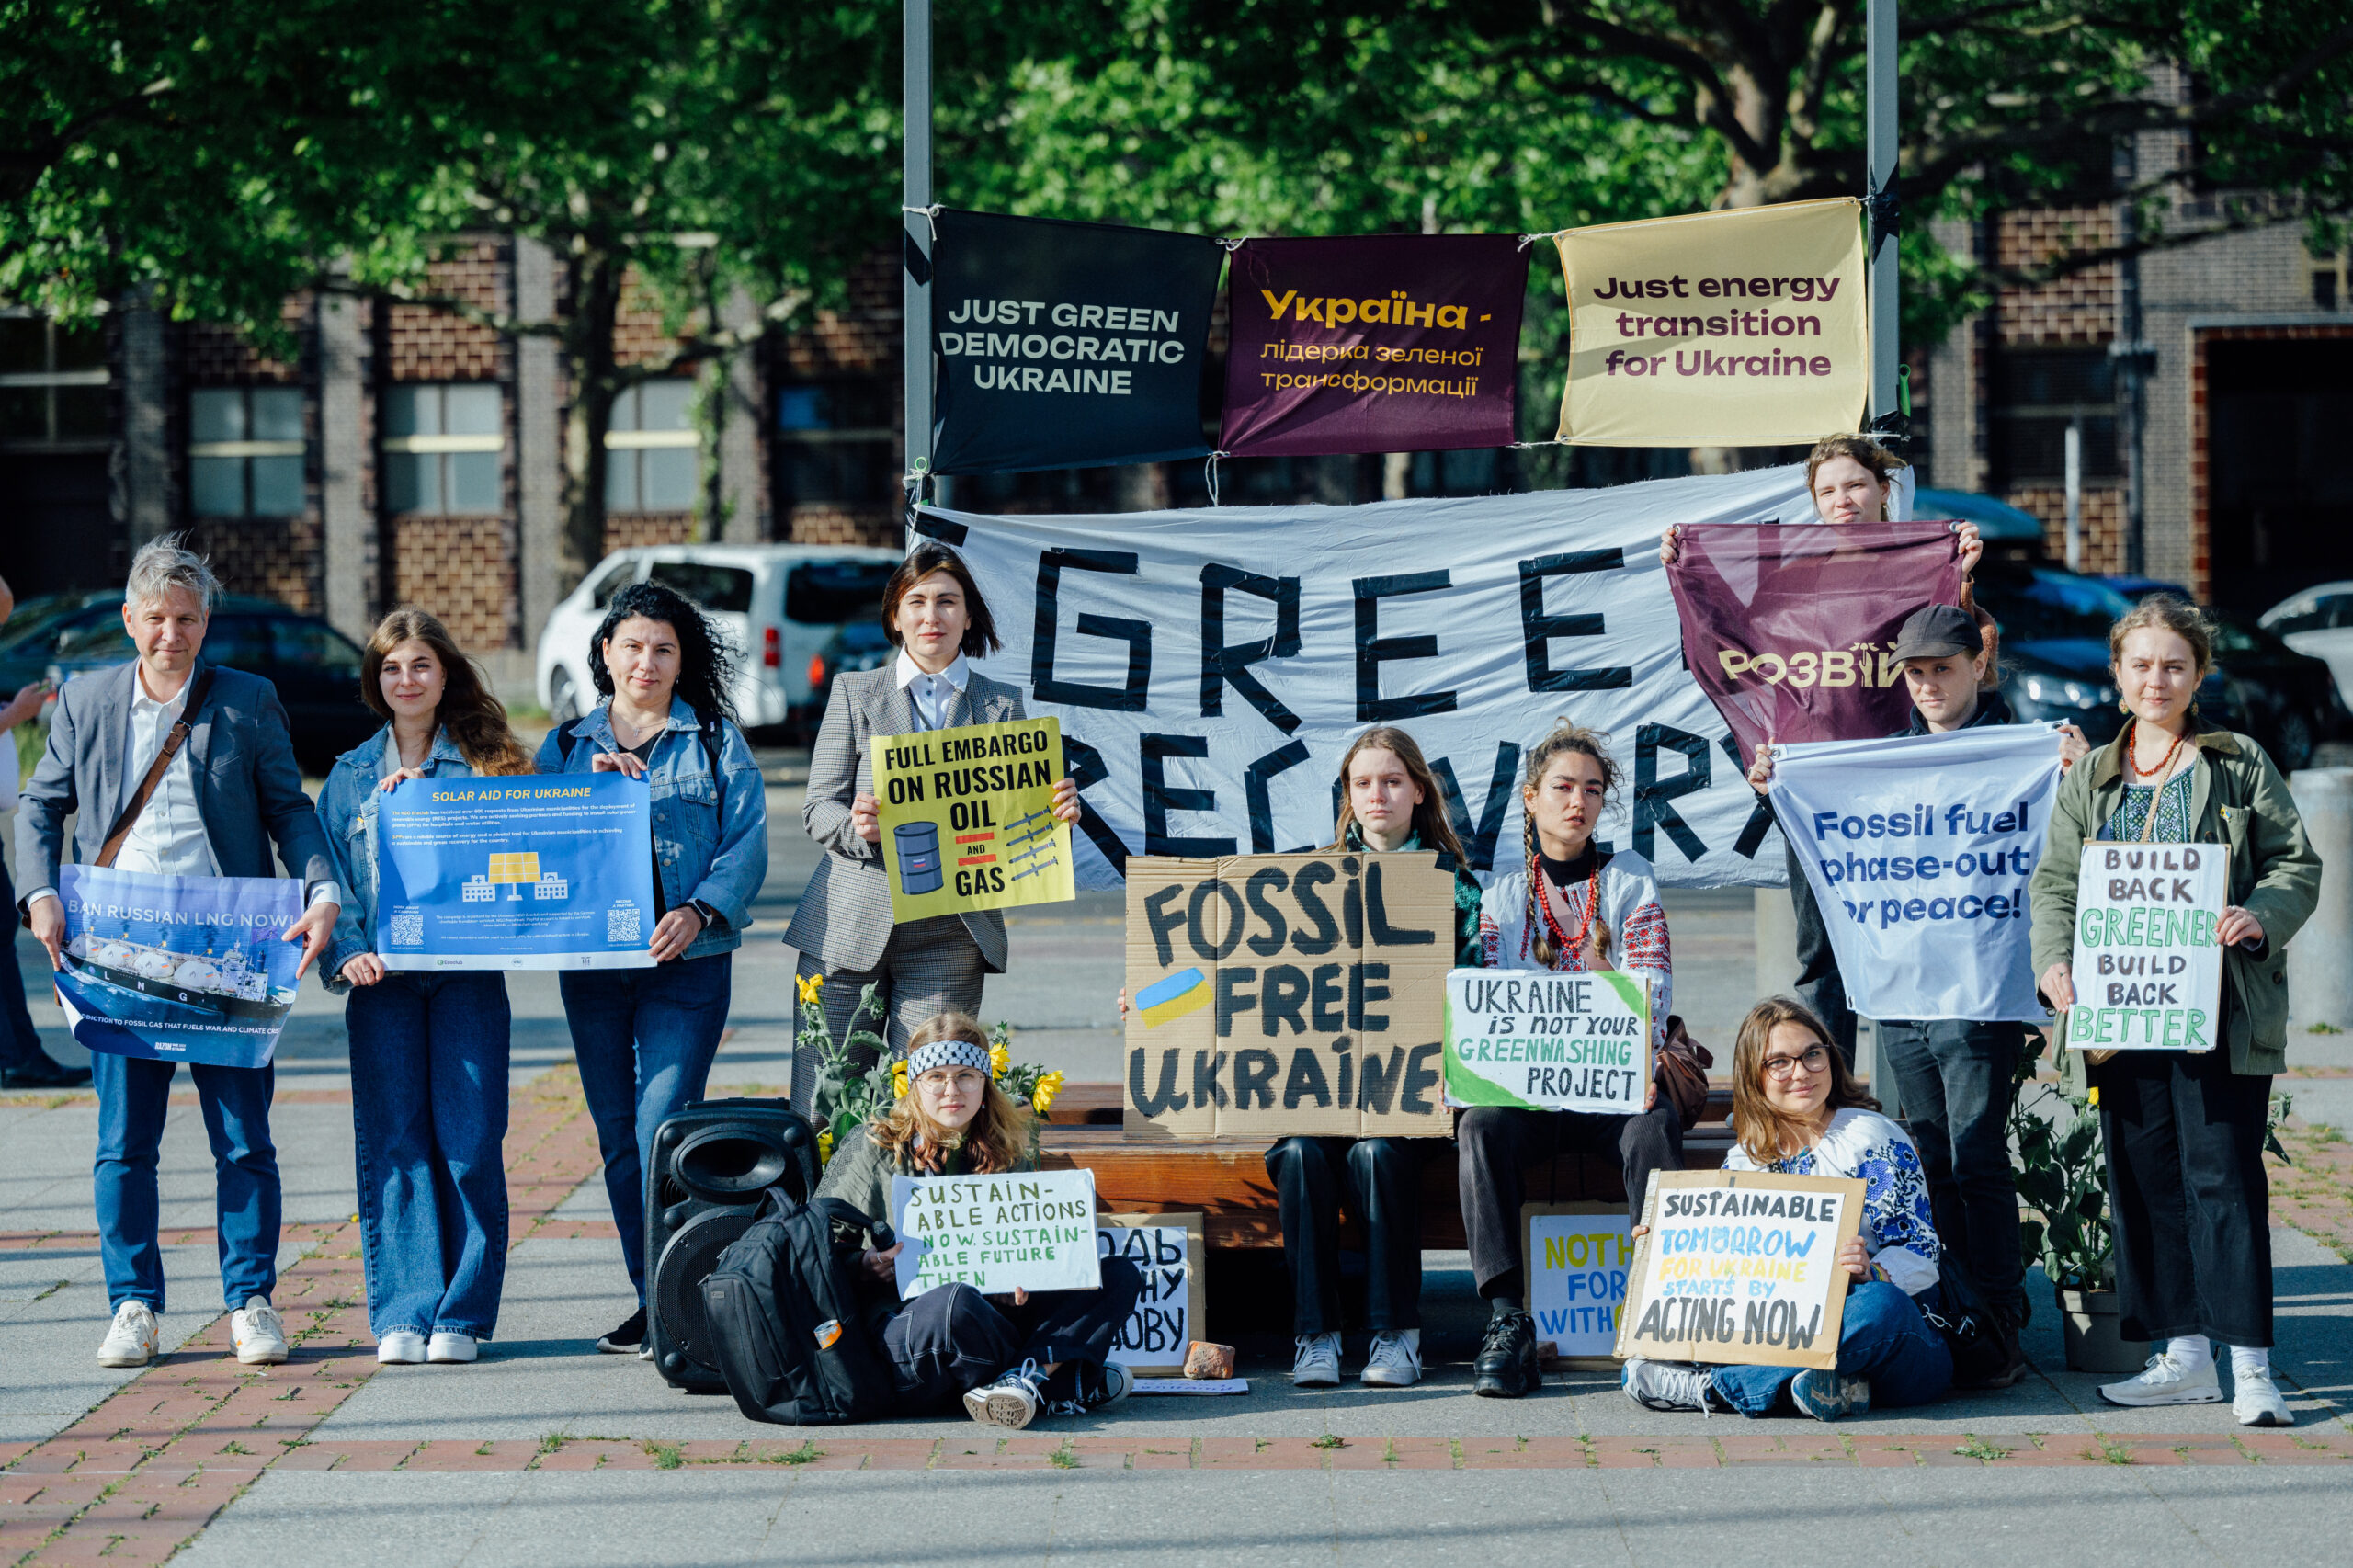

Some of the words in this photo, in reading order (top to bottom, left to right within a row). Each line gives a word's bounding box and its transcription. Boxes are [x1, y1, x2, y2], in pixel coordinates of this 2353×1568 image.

[1593, 275, 1689, 300] Just
[1698, 276, 1841, 303] energy
[949, 299, 1045, 325] JUST
[1051, 303, 1179, 333] GREEN
[1260, 289, 1469, 330] Україна
[1615, 309, 1821, 337] transition
[939, 332, 1185, 364] DEMOCRATIC
[1260, 338, 1369, 364] лідерка
[1374, 347, 1483, 367] зеленої
[1605, 349, 1667, 377] for
[1675, 348, 1832, 377] Ukraine
[974, 364, 1132, 395] UKRAINE
[1260, 369, 1479, 400] трансформації
[884, 744, 936, 770] FULL
[941, 730, 1048, 764] EMBARGO
[432, 791, 475, 802] SOLAR
[478, 790, 502, 801] AID
[505, 789, 531, 800] FOR
[534, 787, 592, 799] UKRAINE
[888, 775, 925, 805] ON
[934, 758, 1051, 800] RUSSIAN
[949, 800, 997, 832] OIL
[1812, 803, 1934, 842] Fossil
[1944, 801, 2029, 837] fuel
[967, 844, 985, 856] AND
[2104, 847, 2201, 871] BUILD
[955, 866, 1006, 897] GAS
[1819, 845, 2031, 888] phase-out
[2108, 877, 2194, 903] BACK
[68, 899, 102, 916] BAN
[107, 904, 188, 925] RUSSIAN
[194, 912, 233, 926] LNG
[240, 914, 294, 927] NOW!
[1881, 888, 2021, 930] peace!
[2080, 907, 2219, 948] GREENER
[2097, 954, 2187, 976] BUILD
[1216, 960, 1393, 1038] FREE
[1464, 979, 1592, 1014] UKRAINE
[2107, 983, 2179, 1006] BACK
[183, 1023, 204, 1031] FUELS
[1488, 1015, 1516, 1035] is
[1586, 1016, 1639, 1036] YOUR
[2071, 1005, 2208, 1047] BETTER
[1458, 1038, 1631, 1066] GREENWASHING
[1526, 1066, 1637, 1102] PROJECT
[918, 1207, 983, 1232] ABLE
[1665, 1190, 1836, 1223] SUSTAINABLE
[918, 1251, 969, 1268] ABLE
[980, 1246, 1056, 1264] FUTURE
[1545, 1233, 1634, 1269] NOTH
[1660, 1225, 1817, 1259] TOMORROW
[916, 1270, 986, 1289] THEN
[1658, 1256, 1703, 1282] FOR
[1709, 1257, 1809, 1283] UKRAINE
[1568, 1270, 1627, 1301] FOR
[1662, 1279, 1735, 1297] STARTS
[1748, 1280, 1777, 1299] BY
[1634, 1297, 1736, 1344] ACTING
[1742, 1299, 1821, 1350] NOW
